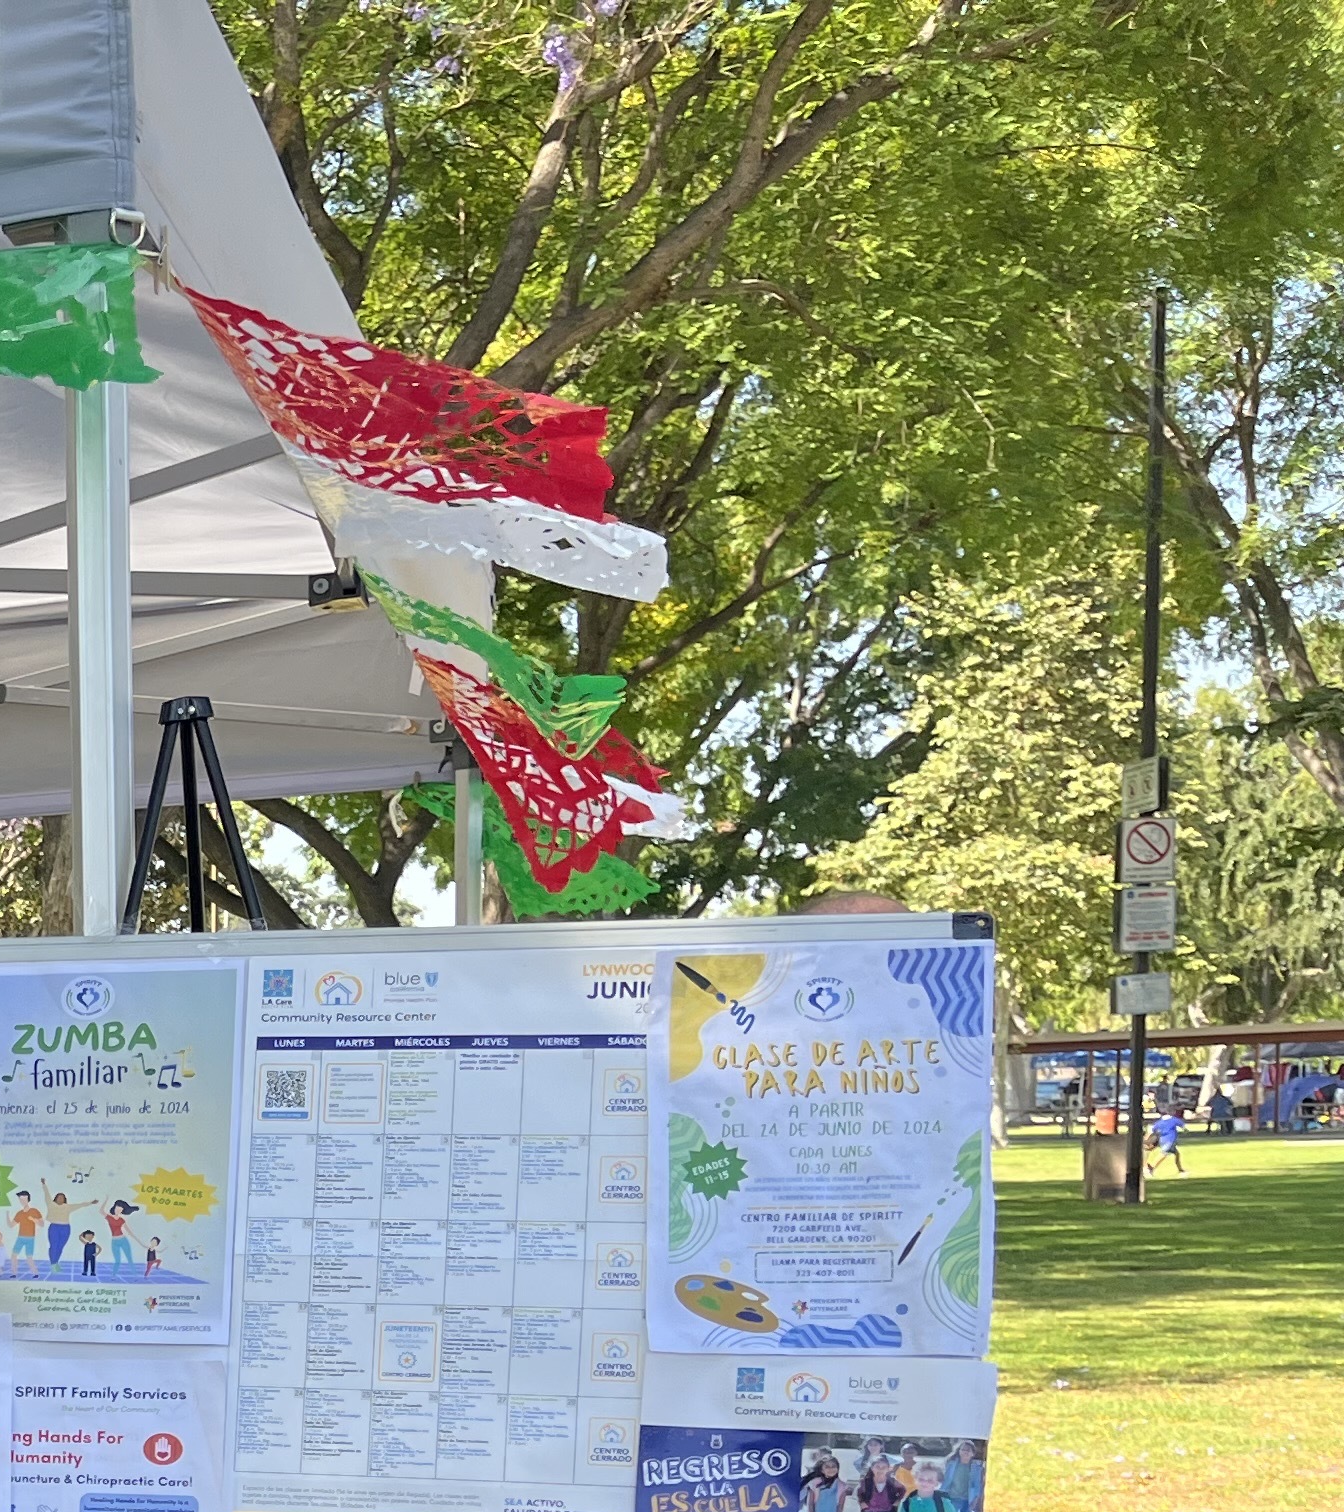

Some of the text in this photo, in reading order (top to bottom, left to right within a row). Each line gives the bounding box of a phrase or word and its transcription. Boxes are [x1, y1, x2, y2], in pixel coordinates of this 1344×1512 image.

[583, 964, 655, 976] LYNWOO
[385, 971, 421, 986] blue
[261, 1011, 437, 1024] Community Resource Center
[12, 1022, 157, 1054] ZUMBA
[274, 1038, 305, 1048] LUNES
[335, 1038, 375, 1047] MARTES
[394, 1036, 451, 1047] MIÉRCOLES
[472, 1037, 509, 1047] JUEVES
[538, 1037, 580, 1046] VIERNES
[714, 1039, 940, 1069] CLASE DE ARTE
[30, 1056, 128, 1090] familiar
[743, 1064, 920, 1099] PARA NIÑOS
[46, 1101, 56, 1114] el
[85, 1101, 98, 1114] de
[105, 1101, 131, 1117] junio
[139, 1101, 151, 1114] de
[158, 1101, 189, 1114] 2024
[789, 1102, 864, 1118] A PARTIR
[722, 1119, 942, 1138] DEL 24 DE JUNIO DE 2024
[789, 1146, 872, 1158] CADA LUNES
[692, 1158, 731, 1176] EDADES
[839, 1161, 857, 1174] AM
[704, 1171, 729, 1185] 11-15
[141, 1184, 203, 1199] LOS MARTES
[741, 1211, 903, 1222] CENTRO FAMILIAR DE SPIRITT
[766, 1235, 844, 1244] BELL CA
[799, 1257, 877, 1266] PARA REGISTRARTE
[602, 1272, 637, 1280] CENTRO
[598, 1279, 640, 1287] CERRADO
[849, 1376, 883, 1389] blue
[15, 1386, 187, 1402] SPIRITT Family Services
[734, 1406, 898, 1422] Community Resource Center
[38, 1430, 93, 1445] Hands
[97, 1431, 125, 1445] For
[594, 1447, 629, 1455] CENTRO
[11, 1451, 83, 1469] umanity
[590, 1454, 632, 1462] CERRADO
[642, 1448, 791, 1487] REGRESO
[64, 1474, 193, 1488] & Chiropractic Care!
[504, 1498, 567, 1510] SEA ACTIVO,
